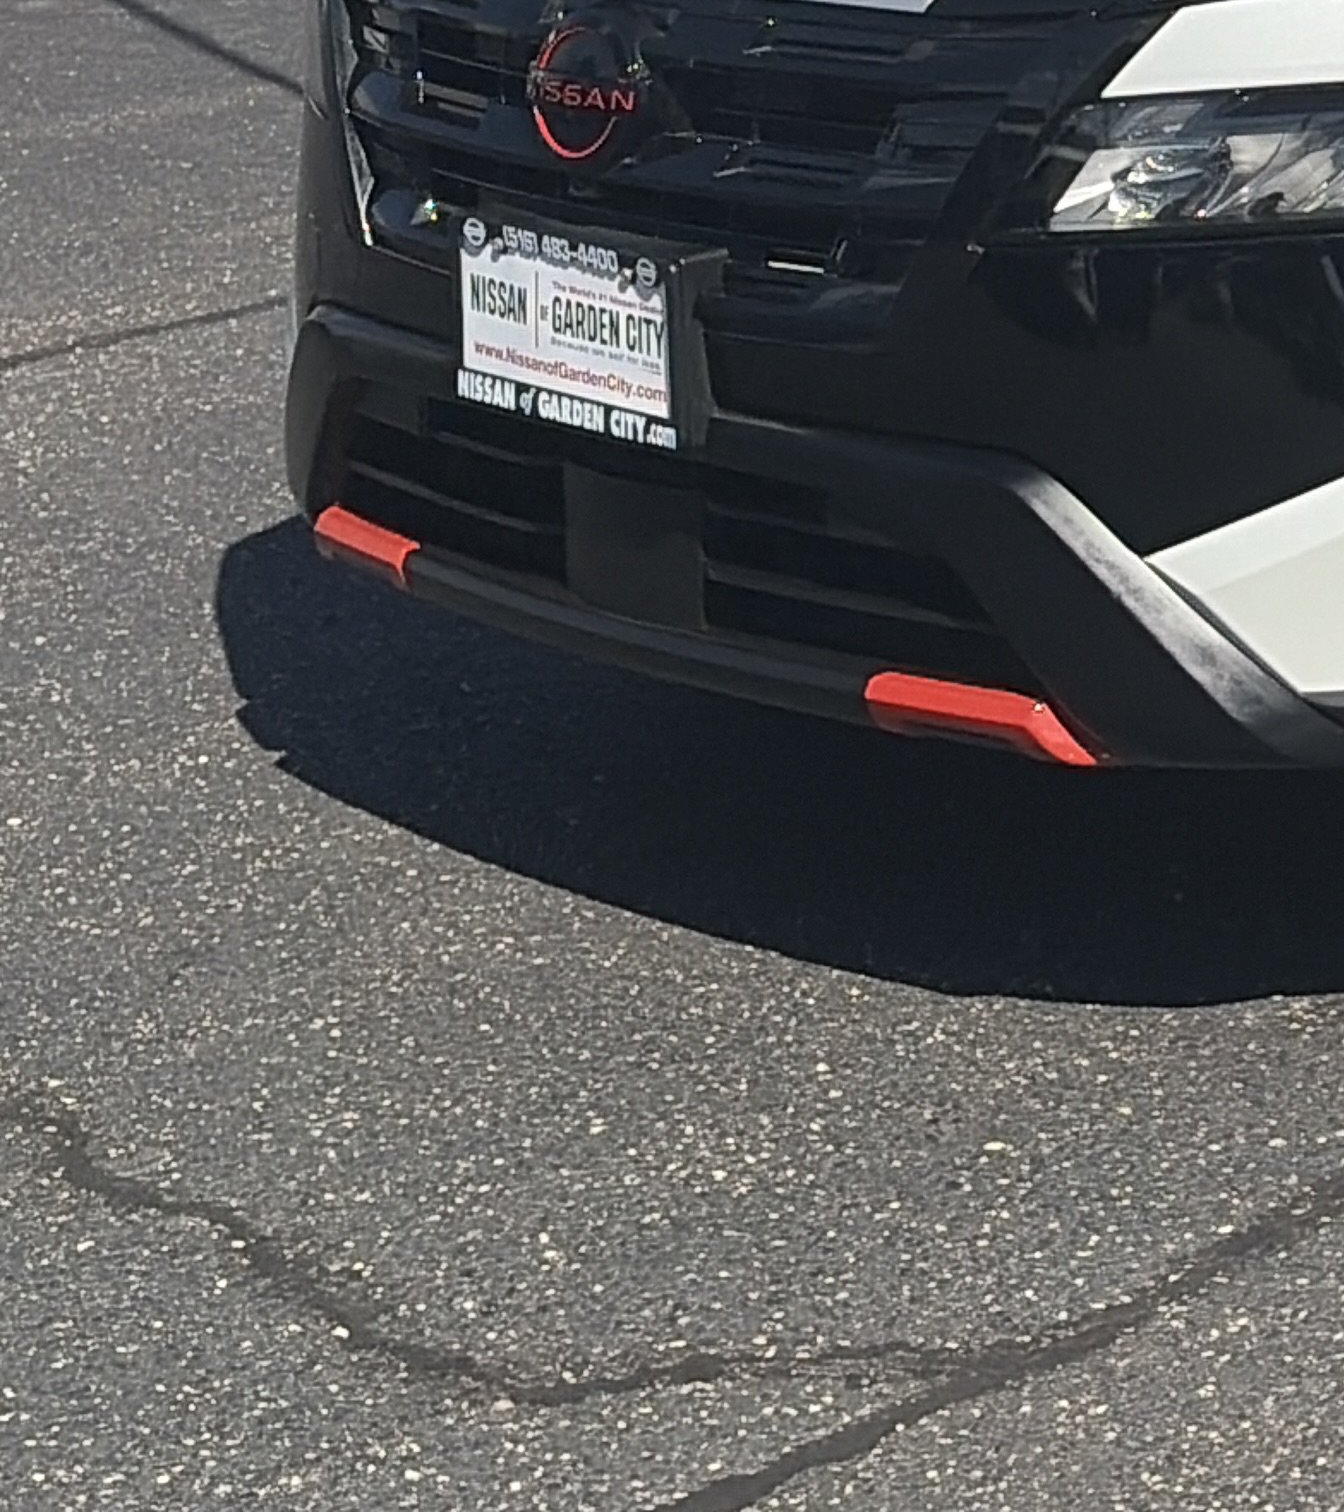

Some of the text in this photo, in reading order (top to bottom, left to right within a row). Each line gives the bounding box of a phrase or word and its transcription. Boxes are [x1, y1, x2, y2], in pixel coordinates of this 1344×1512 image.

[541, 235, 619, 273] 483-4400
[469, 272, 528, 326] NISSAN
[551, 295, 620, 349] GARDEN
[625, 313, 664, 360] CITY
[474, 340, 668, 403] www.NissanofGardenCity.com
[457, 368, 677, 451] NISSAN of GARDEN CITY.com
